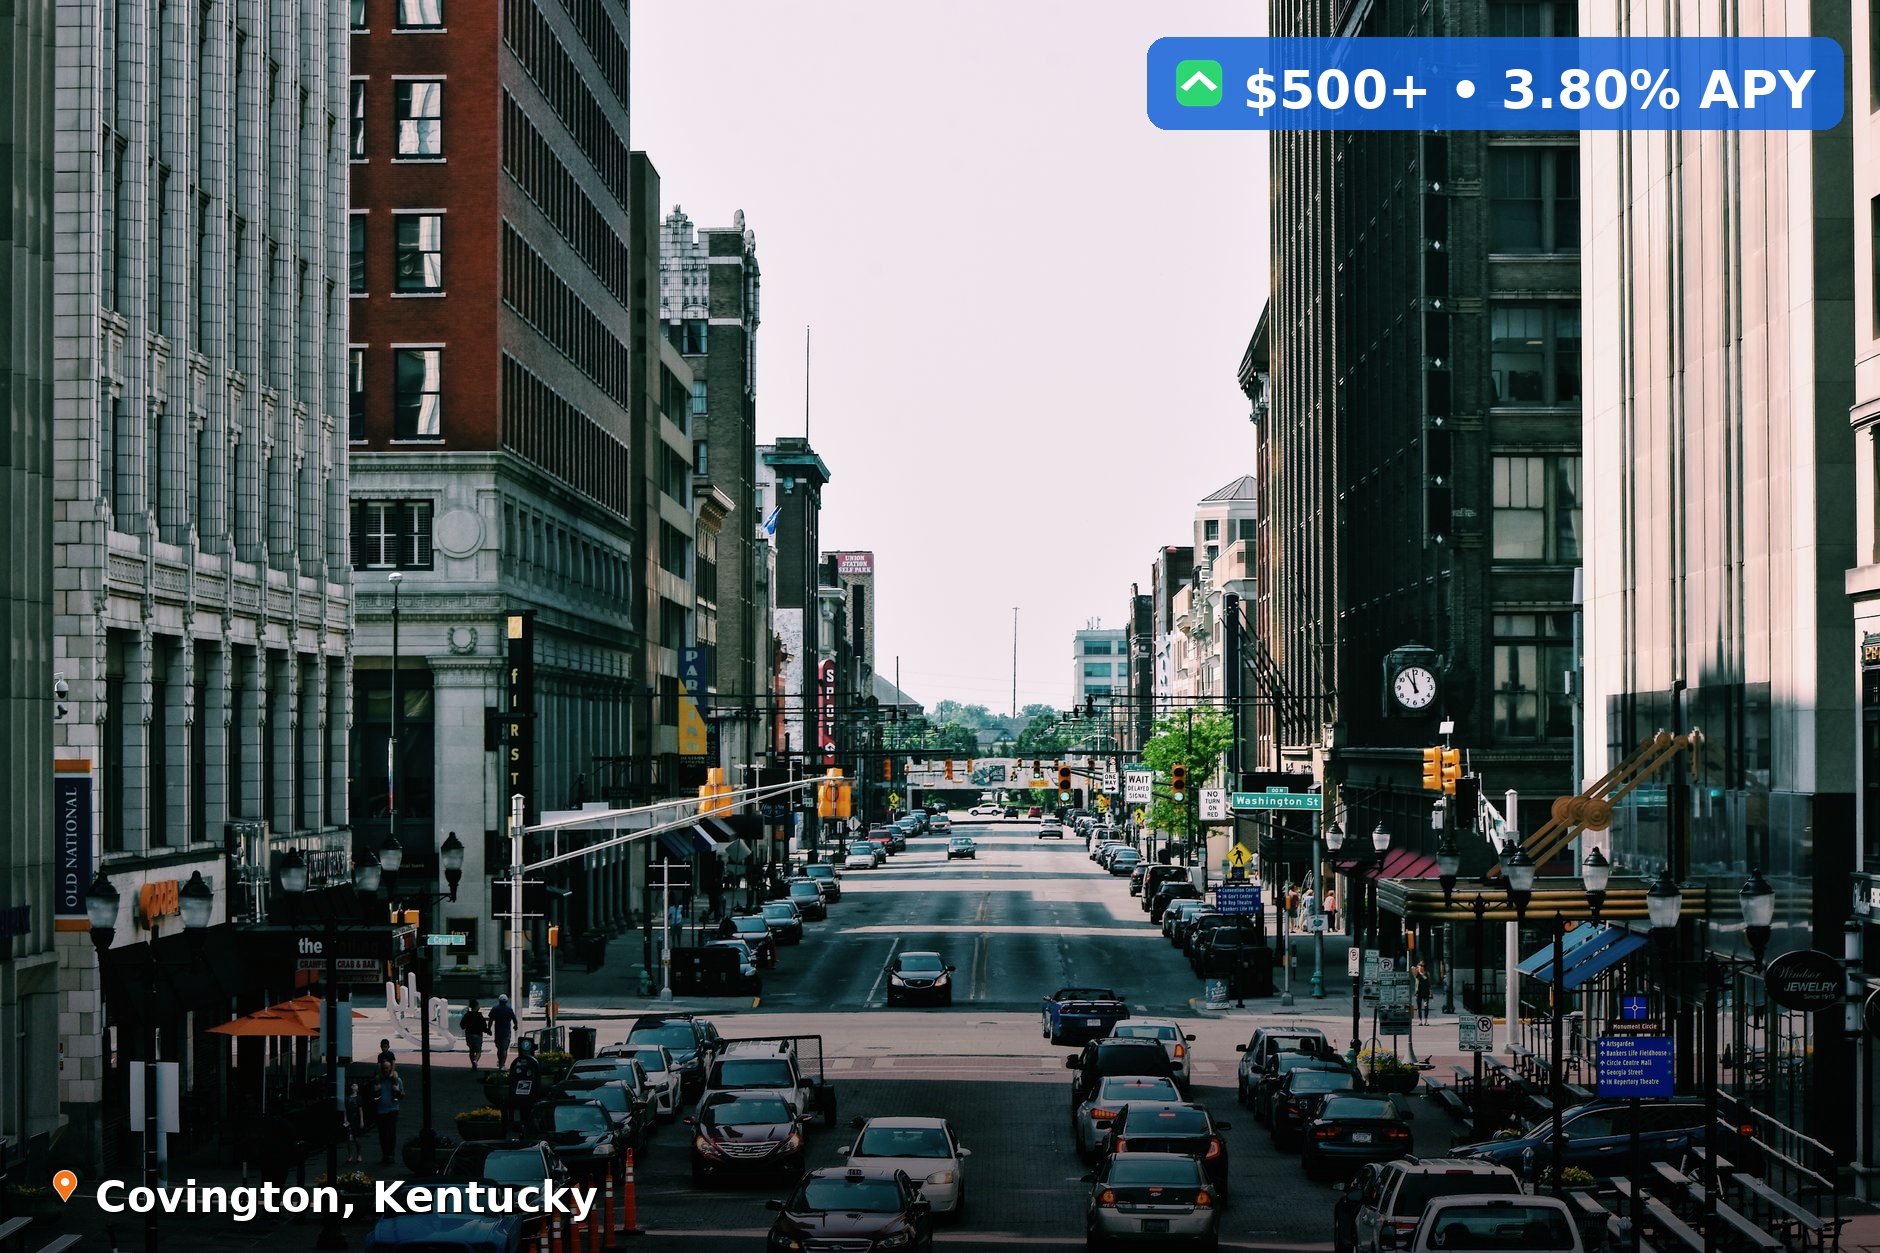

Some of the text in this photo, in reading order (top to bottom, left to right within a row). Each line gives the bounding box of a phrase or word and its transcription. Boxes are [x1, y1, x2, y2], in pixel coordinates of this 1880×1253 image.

[1236, 796, 1318, 807] Washington St
[66, 787, 78, 908] OLD NATIONAL
[298, 938, 323, 954] the
[434, 936, 452, 944] Court
[1773, 966, 1822, 979] Windsor
[1784, 982, 1838, 992] JEWELRY
